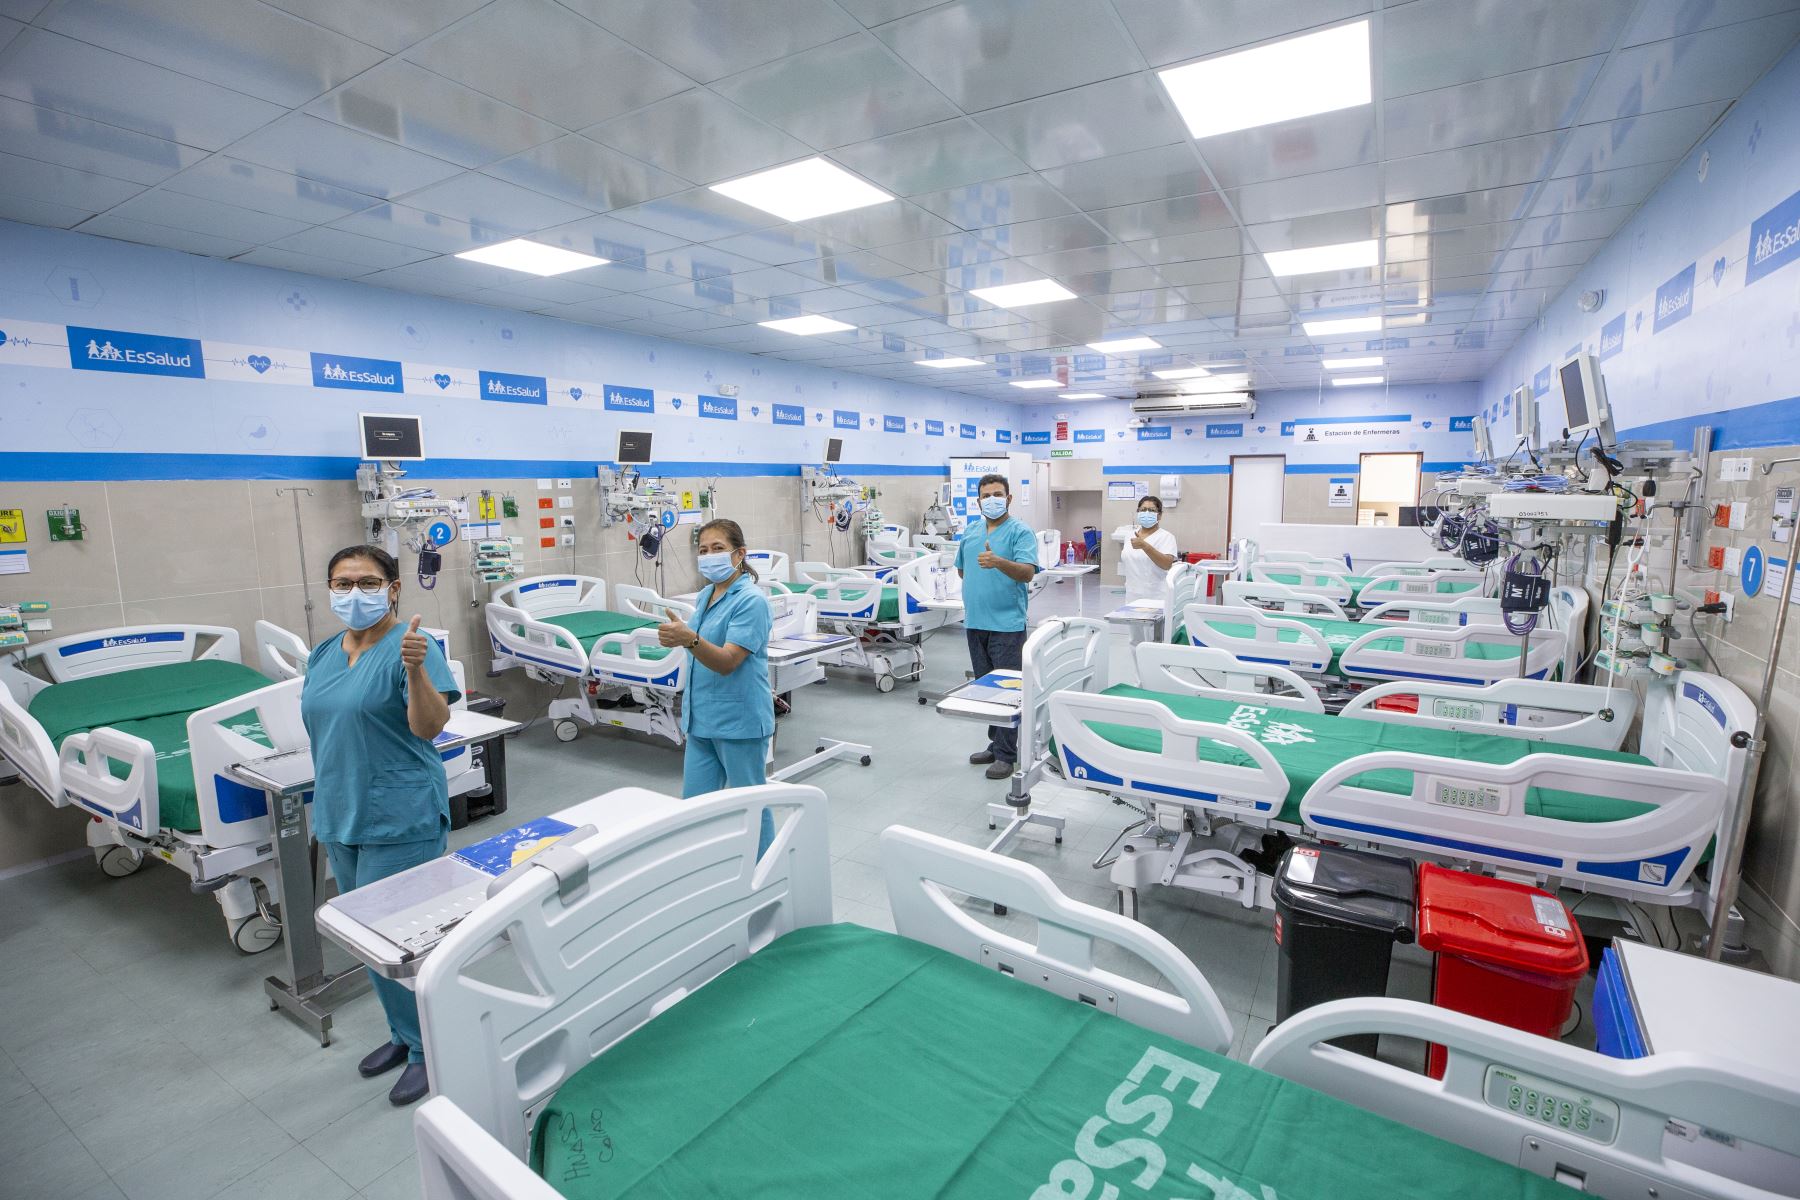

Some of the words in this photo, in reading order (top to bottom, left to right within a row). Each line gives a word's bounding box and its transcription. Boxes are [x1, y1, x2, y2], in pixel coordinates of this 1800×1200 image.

[1668, 288, 1690, 315] EsSalud
[125, 350, 191, 368] EsSalud
[349, 370, 395, 386] EsSalud
[506, 385, 540, 398] EsSalud
[624, 397, 650, 408] EsSalud
[713, 406, 734, 415] EsSalud
[1362, 428, 1400, 436] Enfermeras
[975, 465, 998, 473] EsSalud
[666, 514, 671, 523] 3
[436, 527, 445, 540] 2
[1749, 557, 1756, 582] 7
[117, 636, 147, 646] EsSalud
